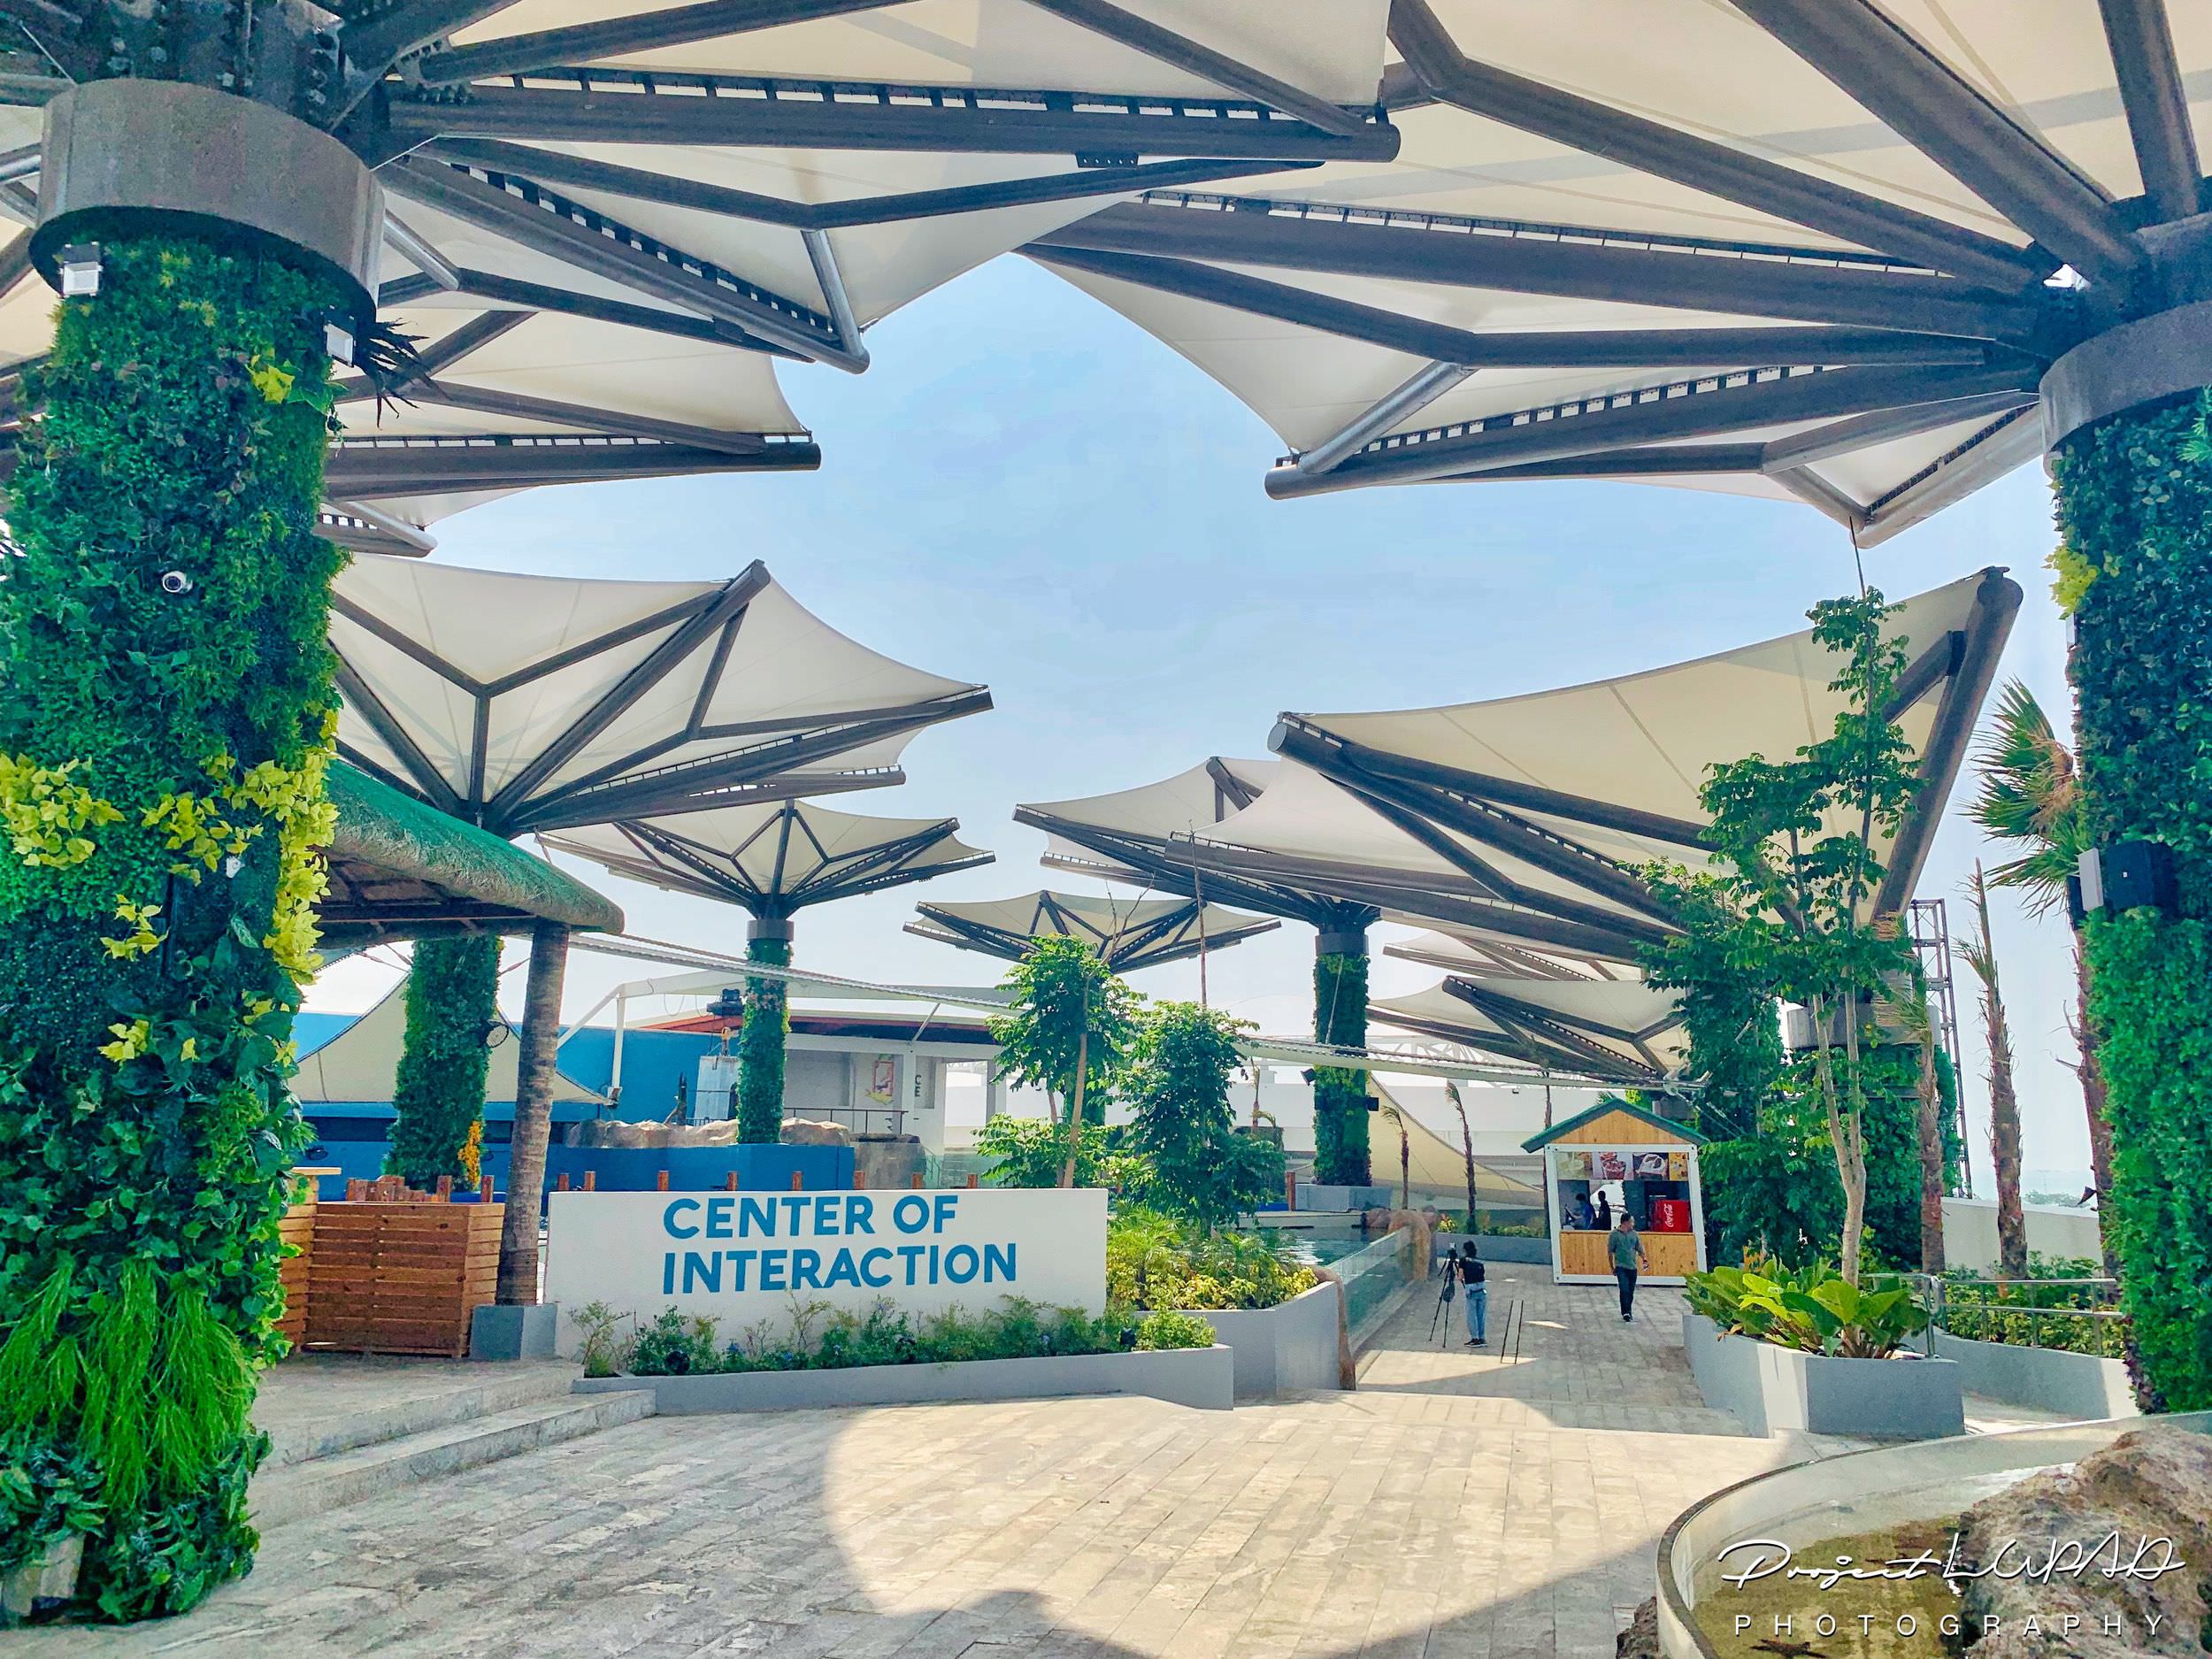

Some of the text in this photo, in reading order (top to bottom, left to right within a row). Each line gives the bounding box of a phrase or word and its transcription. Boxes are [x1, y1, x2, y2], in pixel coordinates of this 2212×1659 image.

[663, 1194, 959, 1240] CENTER OF
[663, 1242, 1017, 1294] INTERACTION
